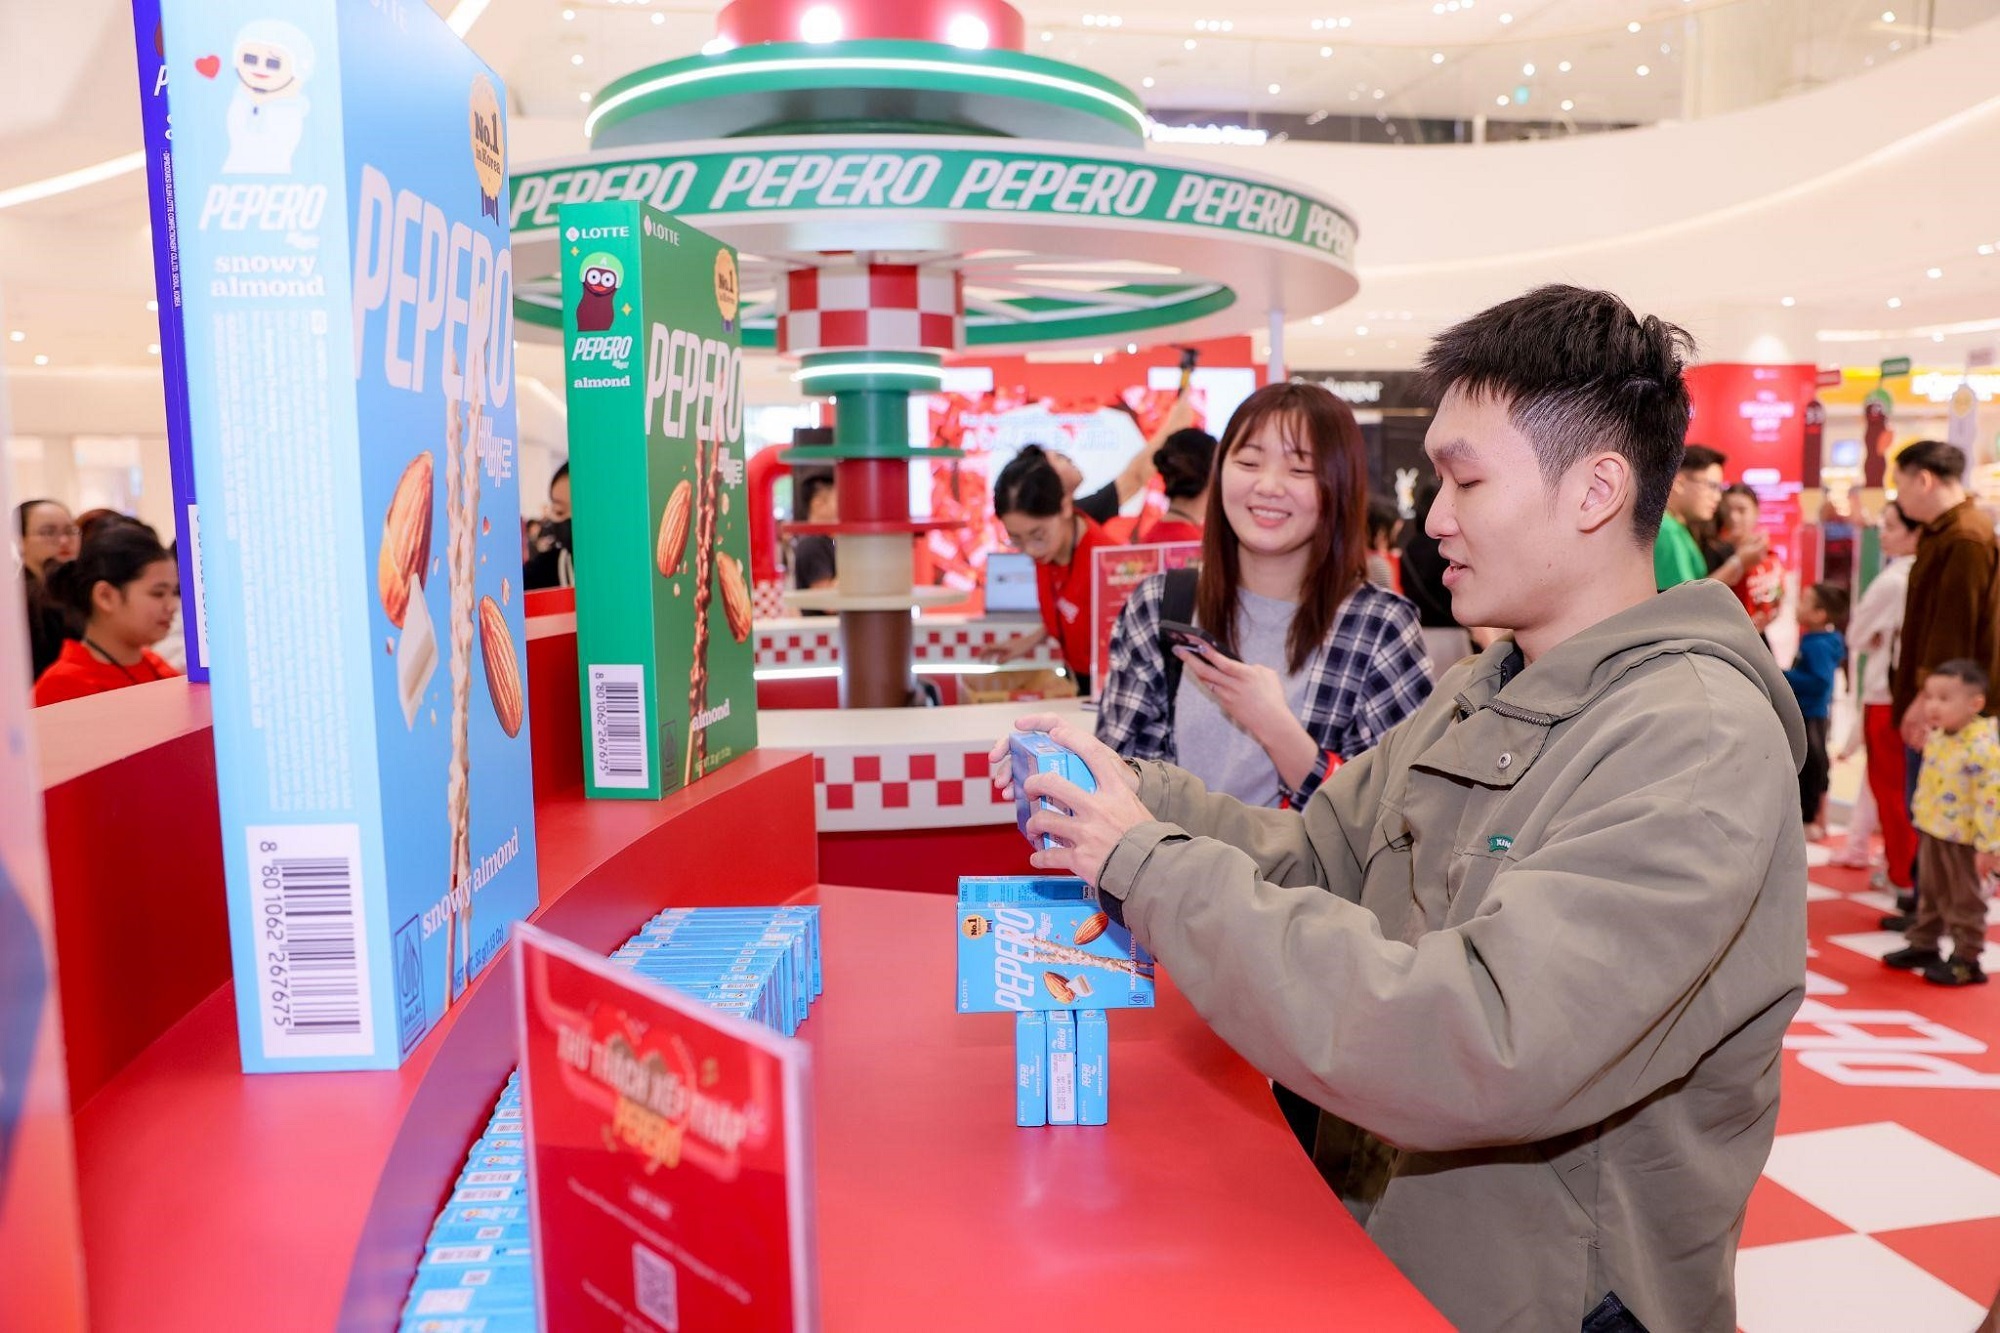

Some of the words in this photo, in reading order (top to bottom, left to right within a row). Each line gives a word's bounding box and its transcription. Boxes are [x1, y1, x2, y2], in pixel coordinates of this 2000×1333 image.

[474, 111, 499, 155] No.1
[198, 183, 328, 232] PEPERO
[511, 161, 699, 230] PEPERO
[709, 154, 942, 210] PEPERO
[949, 159, 1157, 216] PEPERO
[1166, 174, 1300, 237] PEPERO
[582, 226, 630, 240] LOTTE
[652, 222, 680, 247] LOTTE
[211, 275, 325, 297] almond
[215, 255, 317, 277] snowy
[352, 163, 513, 409] PEPERO
[572, 335, 633, 361] PEPERO
[574, 375, 631, 389] almond
[644, 321, 745, 444] PEPERO
[692, 698, 731, 731] almond
[598, 730, 610, 772] 267675
[260, 841, 278, 853] 8
[262, 865, 285, 941] 801062
[422, 874, 473, 942] snowy
[472, 826, 520, 892] almond
[995, 909, 1035, 1012] PEPERO
[267, 951, 292, 1027] 267675
